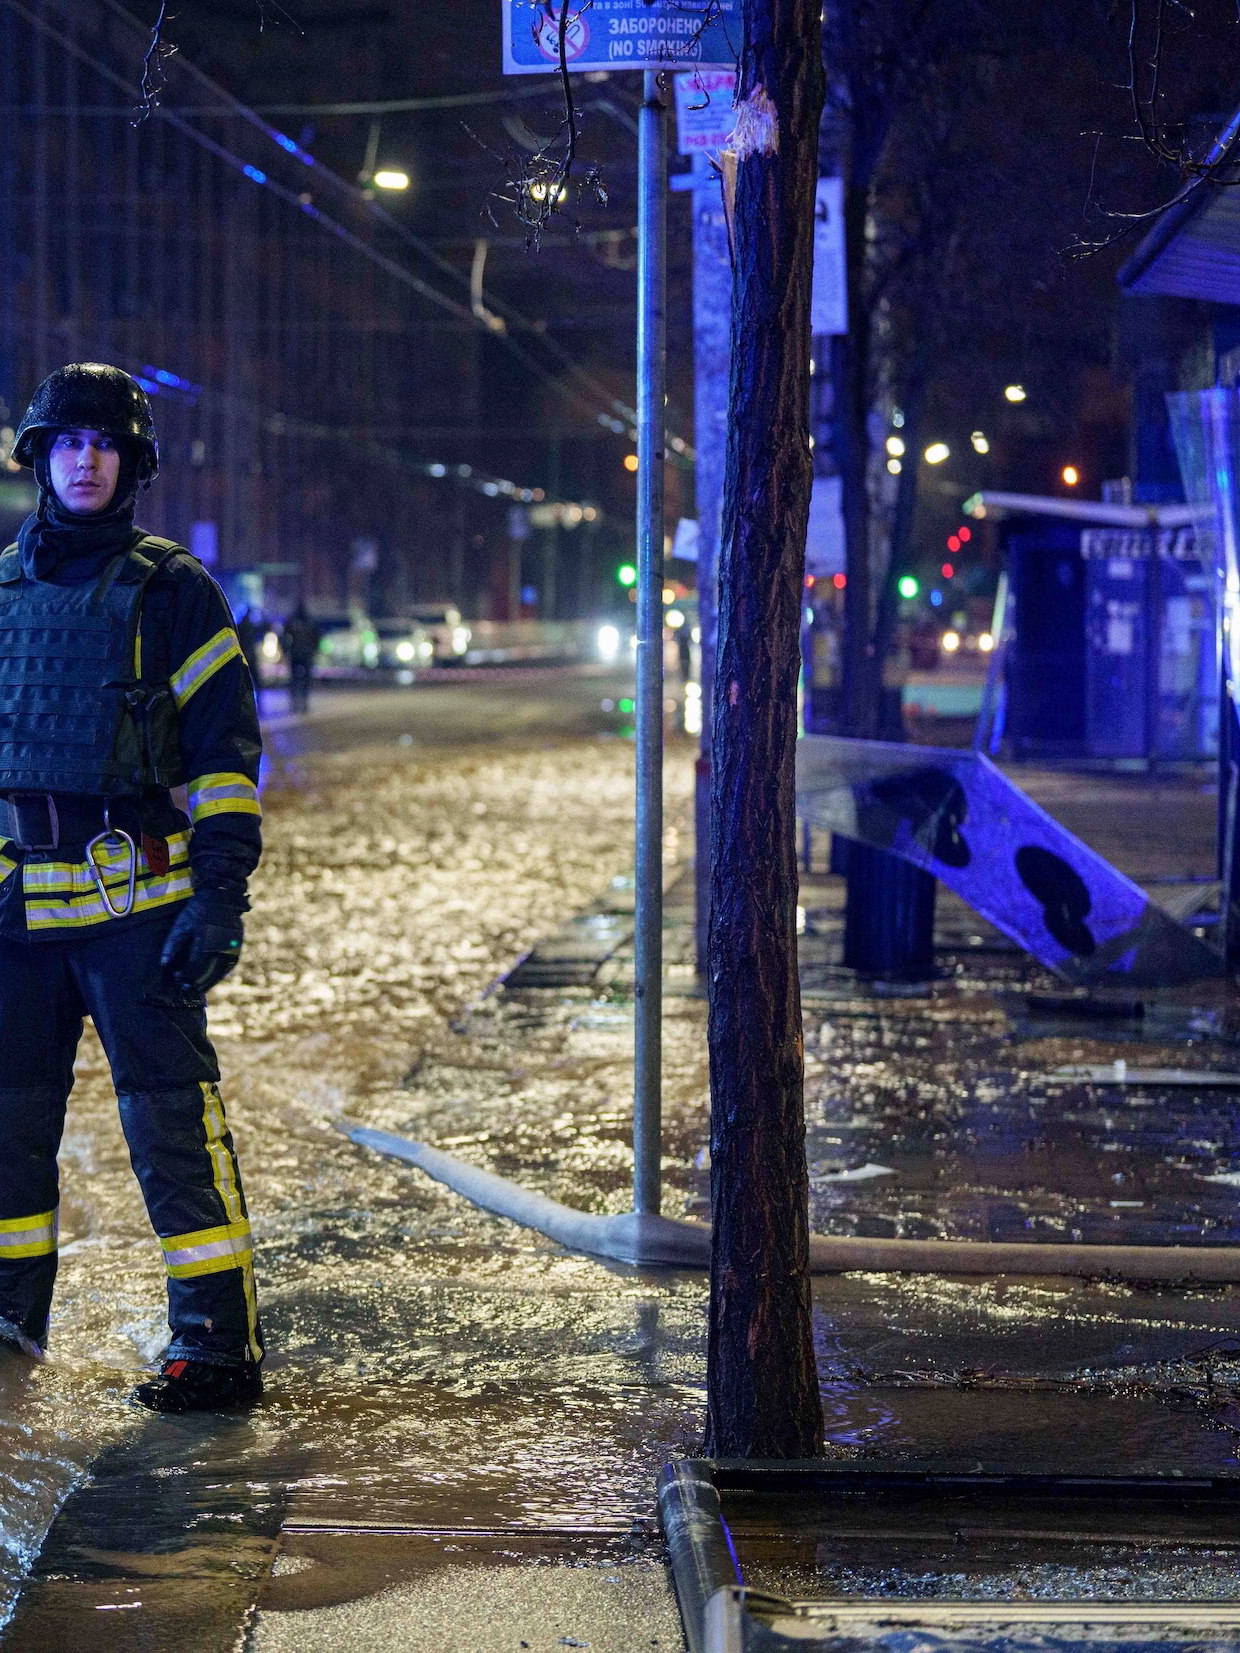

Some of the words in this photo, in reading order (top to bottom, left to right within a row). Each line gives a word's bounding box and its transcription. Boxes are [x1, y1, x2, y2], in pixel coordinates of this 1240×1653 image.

[593, 1, 603, 10] та
[613, 1, 633, 9] зоні
[608, 17, 702, 35] ЗАБОРОНЕНО
[608, 40, 633, 60] (NO
[637, 39, 702, 60] SMOKING)
